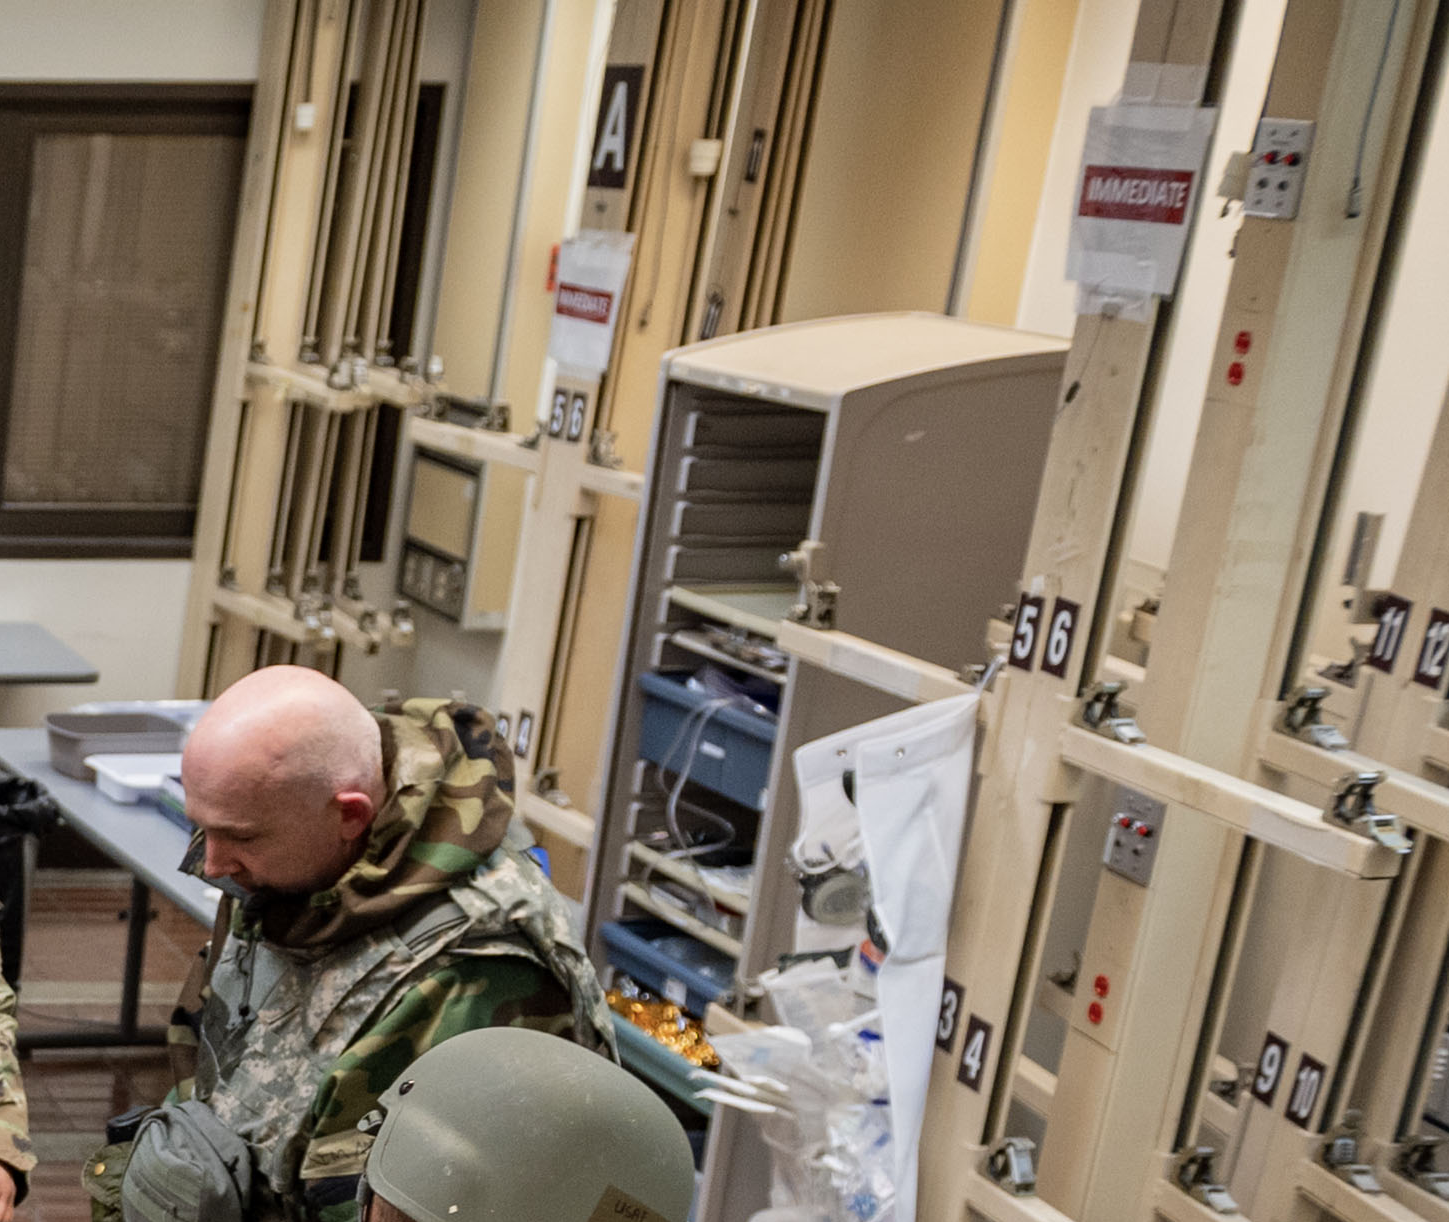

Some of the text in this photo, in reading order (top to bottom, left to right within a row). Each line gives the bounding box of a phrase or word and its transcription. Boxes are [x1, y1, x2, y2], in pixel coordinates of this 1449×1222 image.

[594, 81, 628, 172] A
[1087, 176, 1190, 209] IMMEDIATE
[551, 394, 584, 437] 5 6
[1013, 604, 1072, 667] 5 6
[1373, 605, 1449, 677] 11 12
[937, 989, 985, 1080] 3 4
[1256, 1043, 1320, 1118] 9 10
